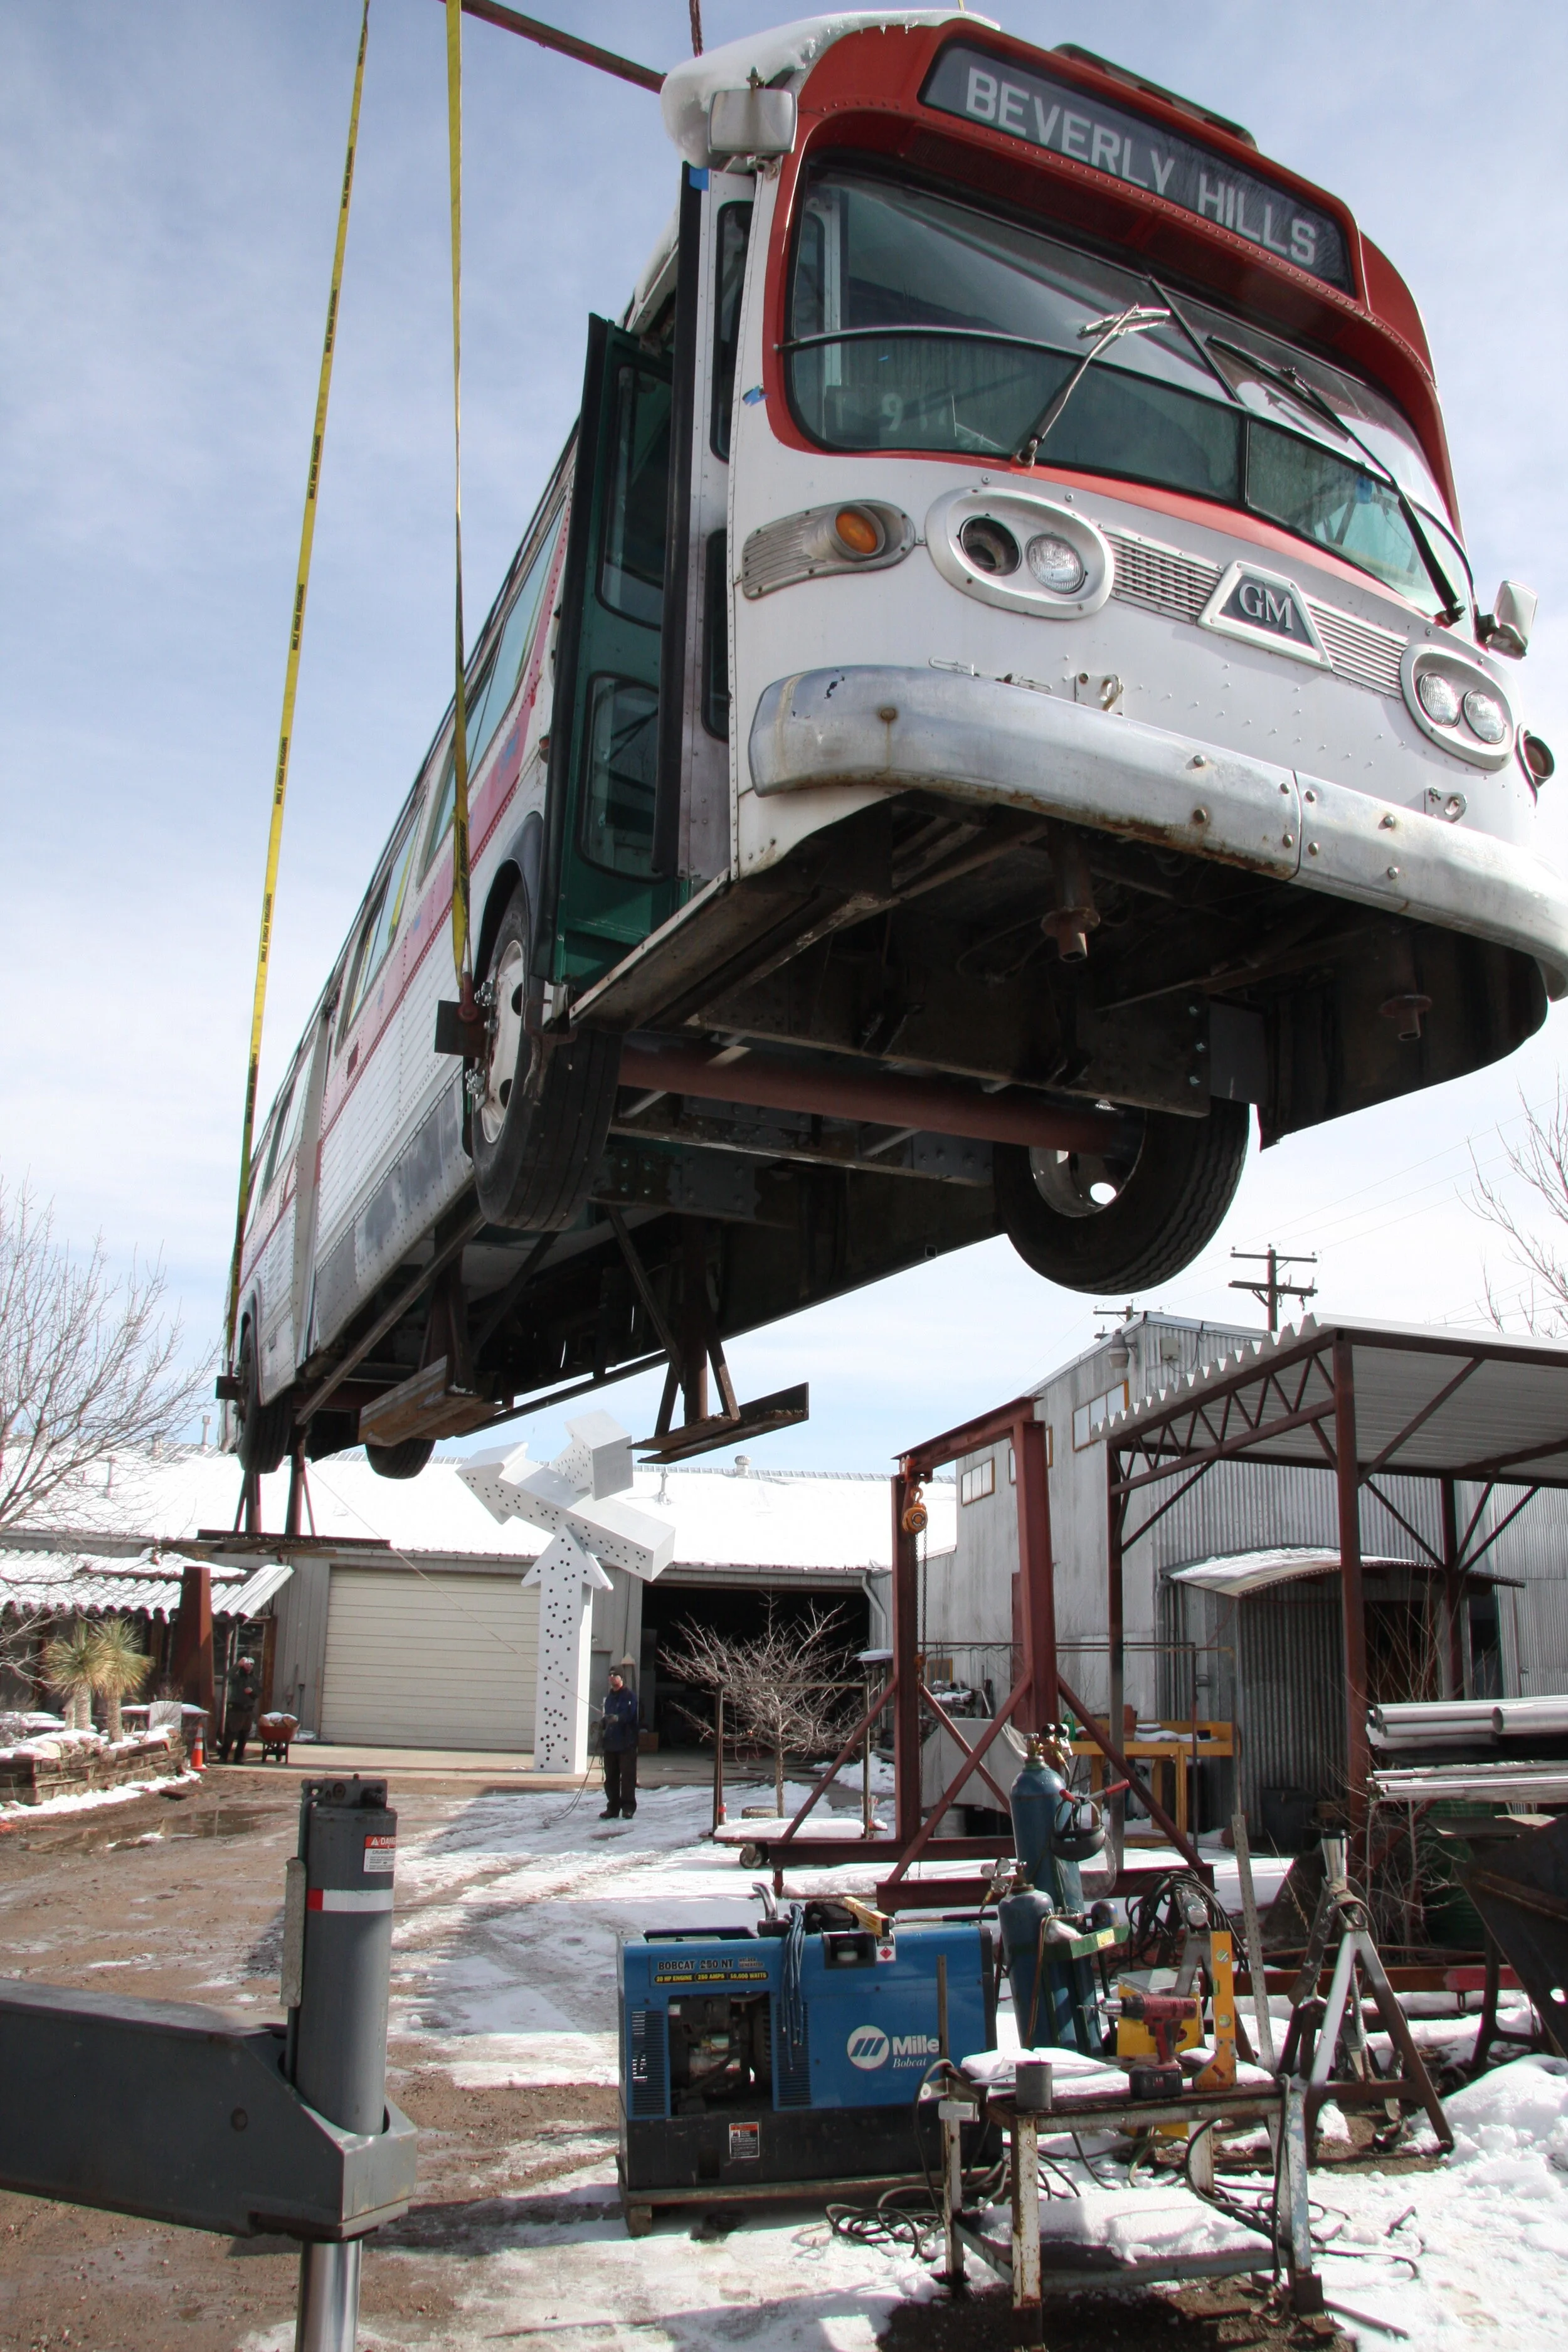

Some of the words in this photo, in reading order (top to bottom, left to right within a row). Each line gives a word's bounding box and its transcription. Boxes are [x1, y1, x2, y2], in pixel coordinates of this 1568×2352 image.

[966, 67, 1175, 196] BEVERLY
[1197, 172, 1317, 266] HILLS
[1239, 584, 1293, 631] GM
[264, 893, 272, 923] RIGGING
[658, 1960, 695, 1970] BOBCAT
[700, 1959, 718, 1969] 250
[721, 1959, 733, 1968] NT
[893, 2035, 940, 2055] Mille
[893, 2057, 927, 2068] Bobcat
